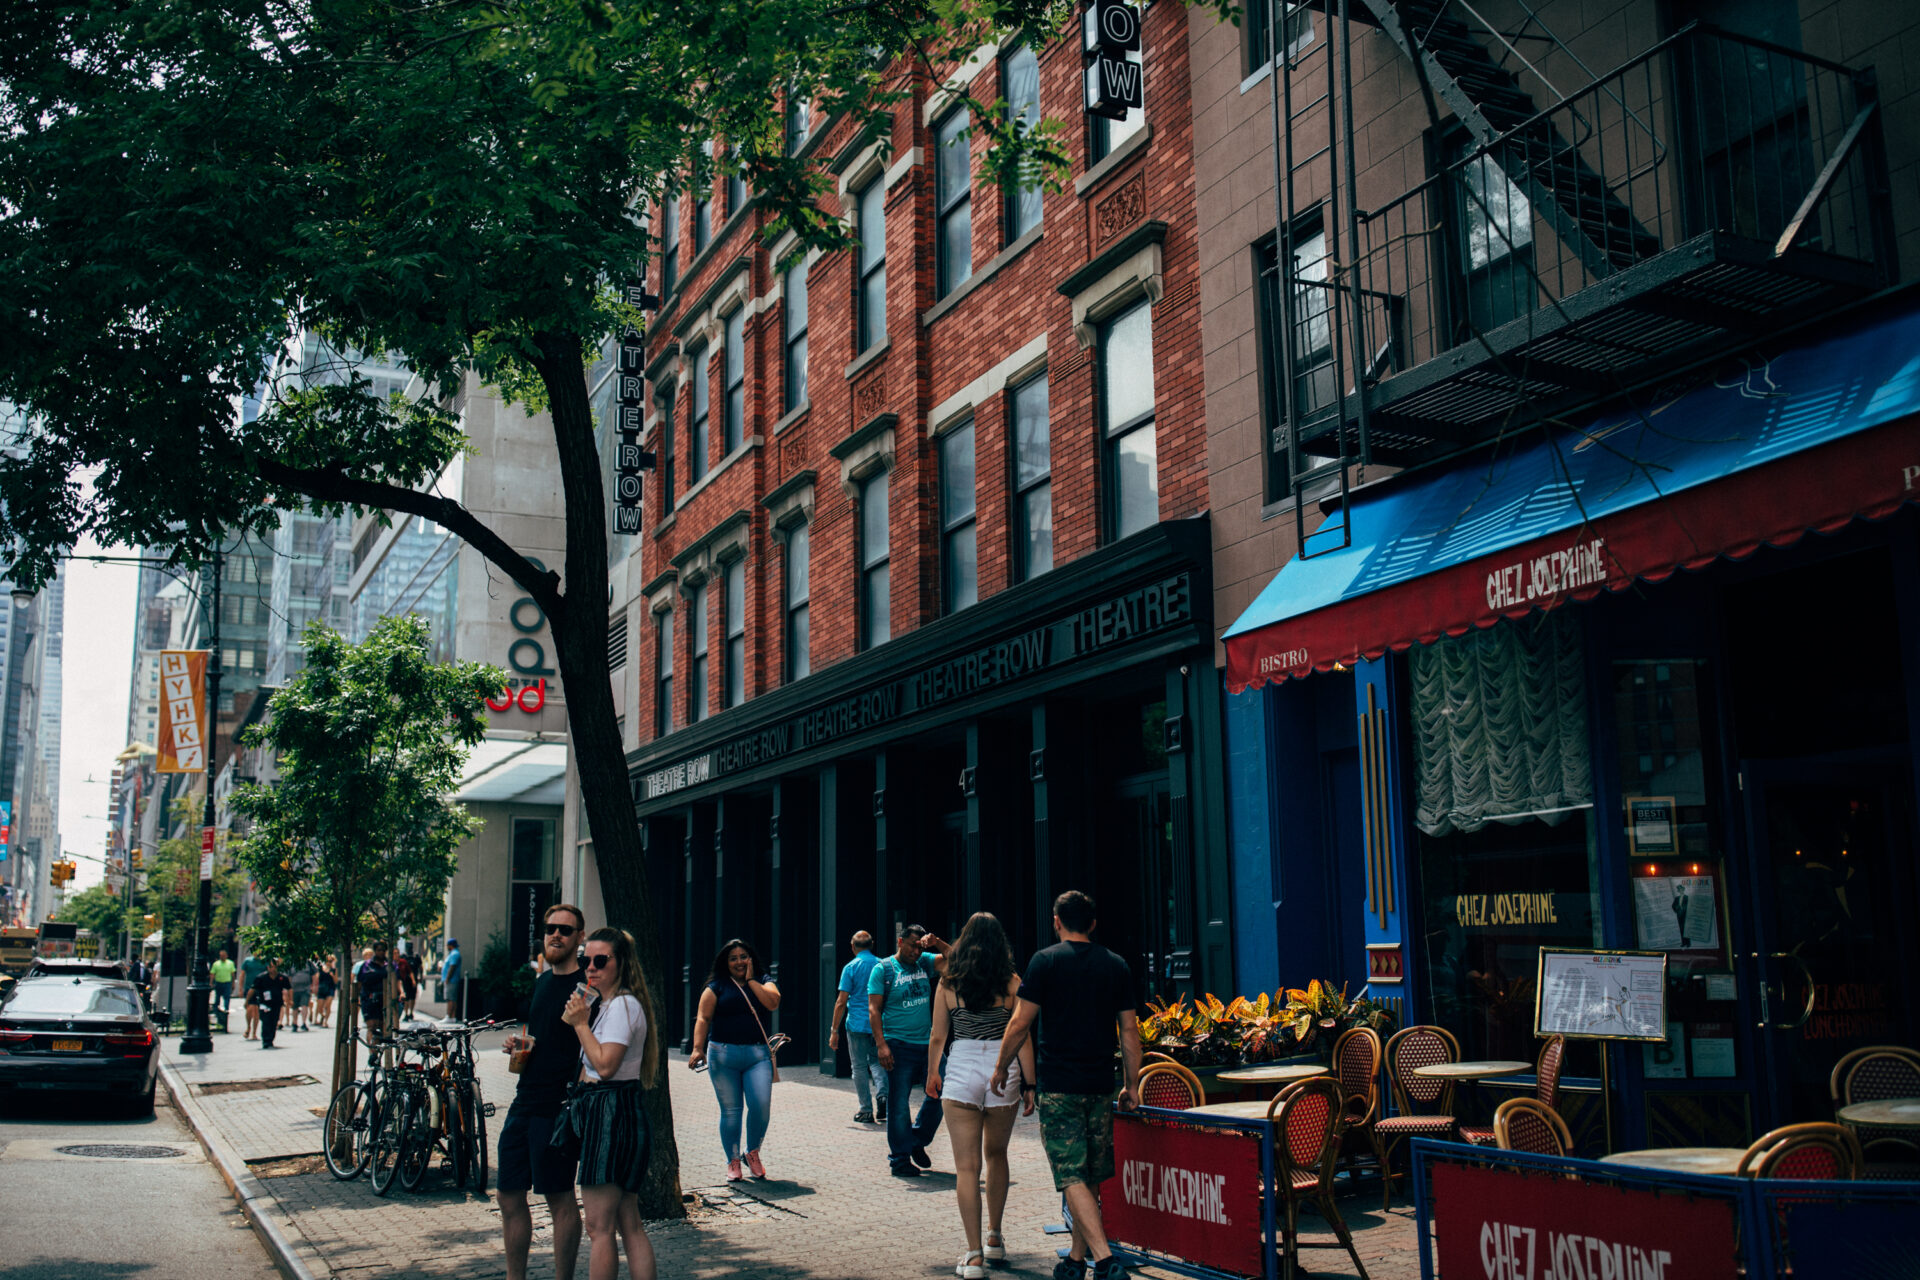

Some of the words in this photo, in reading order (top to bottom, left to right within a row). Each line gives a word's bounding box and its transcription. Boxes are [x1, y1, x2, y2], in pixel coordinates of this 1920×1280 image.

[623, 257, 643, 430] EATRE
[619, 445, 641, 530] ROW
[1487, 563, 1525, 610] CHEZ
[1066, 576, 1180, 654] THEATRE
[911, 648, 992, 707] THEATRE
[995, 629, 1045, 684] ROW
[1260, 648, 1308, 673] BISTRO
[800, 696, 857, 746] THEATRE
[861, 683, 897, 726] ROW
[717, 733, 759, 774] THEATRE
[761, 722, 790, 760] ROW
[647, 763, 686, 798] THEATRE
[687, 754, 710, 786] ROW
[1456, 895, 1488, 927] CHEZ
[1490, 893, 1557, 925] JOSEPHINE
[1122, 1160, 1157, 1209] CHEZ
[1480, 1221, 1536, 1280] CHEZ
